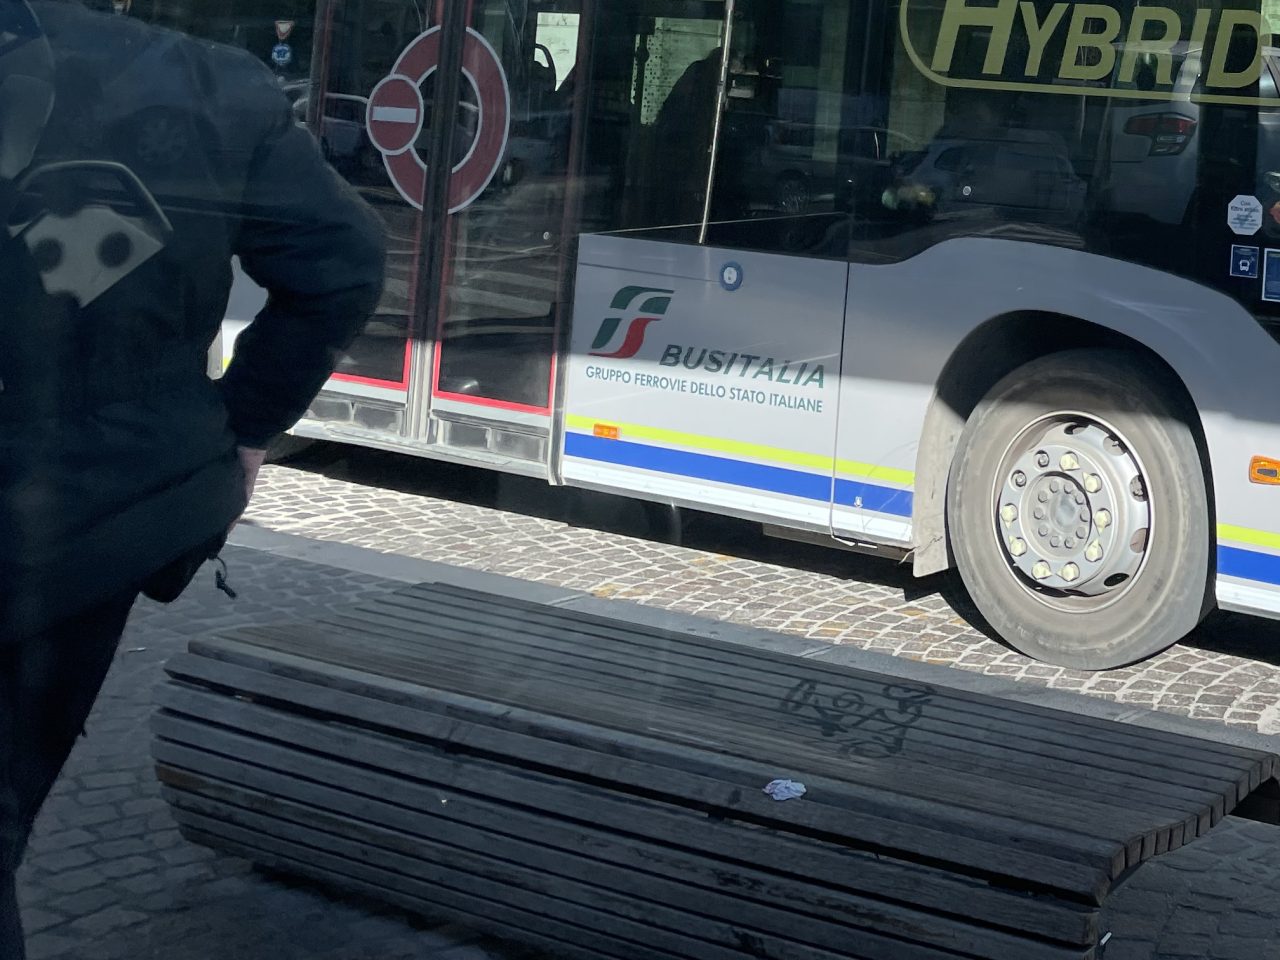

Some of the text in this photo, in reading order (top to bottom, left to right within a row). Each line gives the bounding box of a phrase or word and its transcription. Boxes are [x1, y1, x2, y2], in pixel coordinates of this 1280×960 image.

[585, 365, 824, 414] GRUPPO FERROVIE DELLO STATO ITALIANE
[658, 343, 825, 389] BUSITALIA
